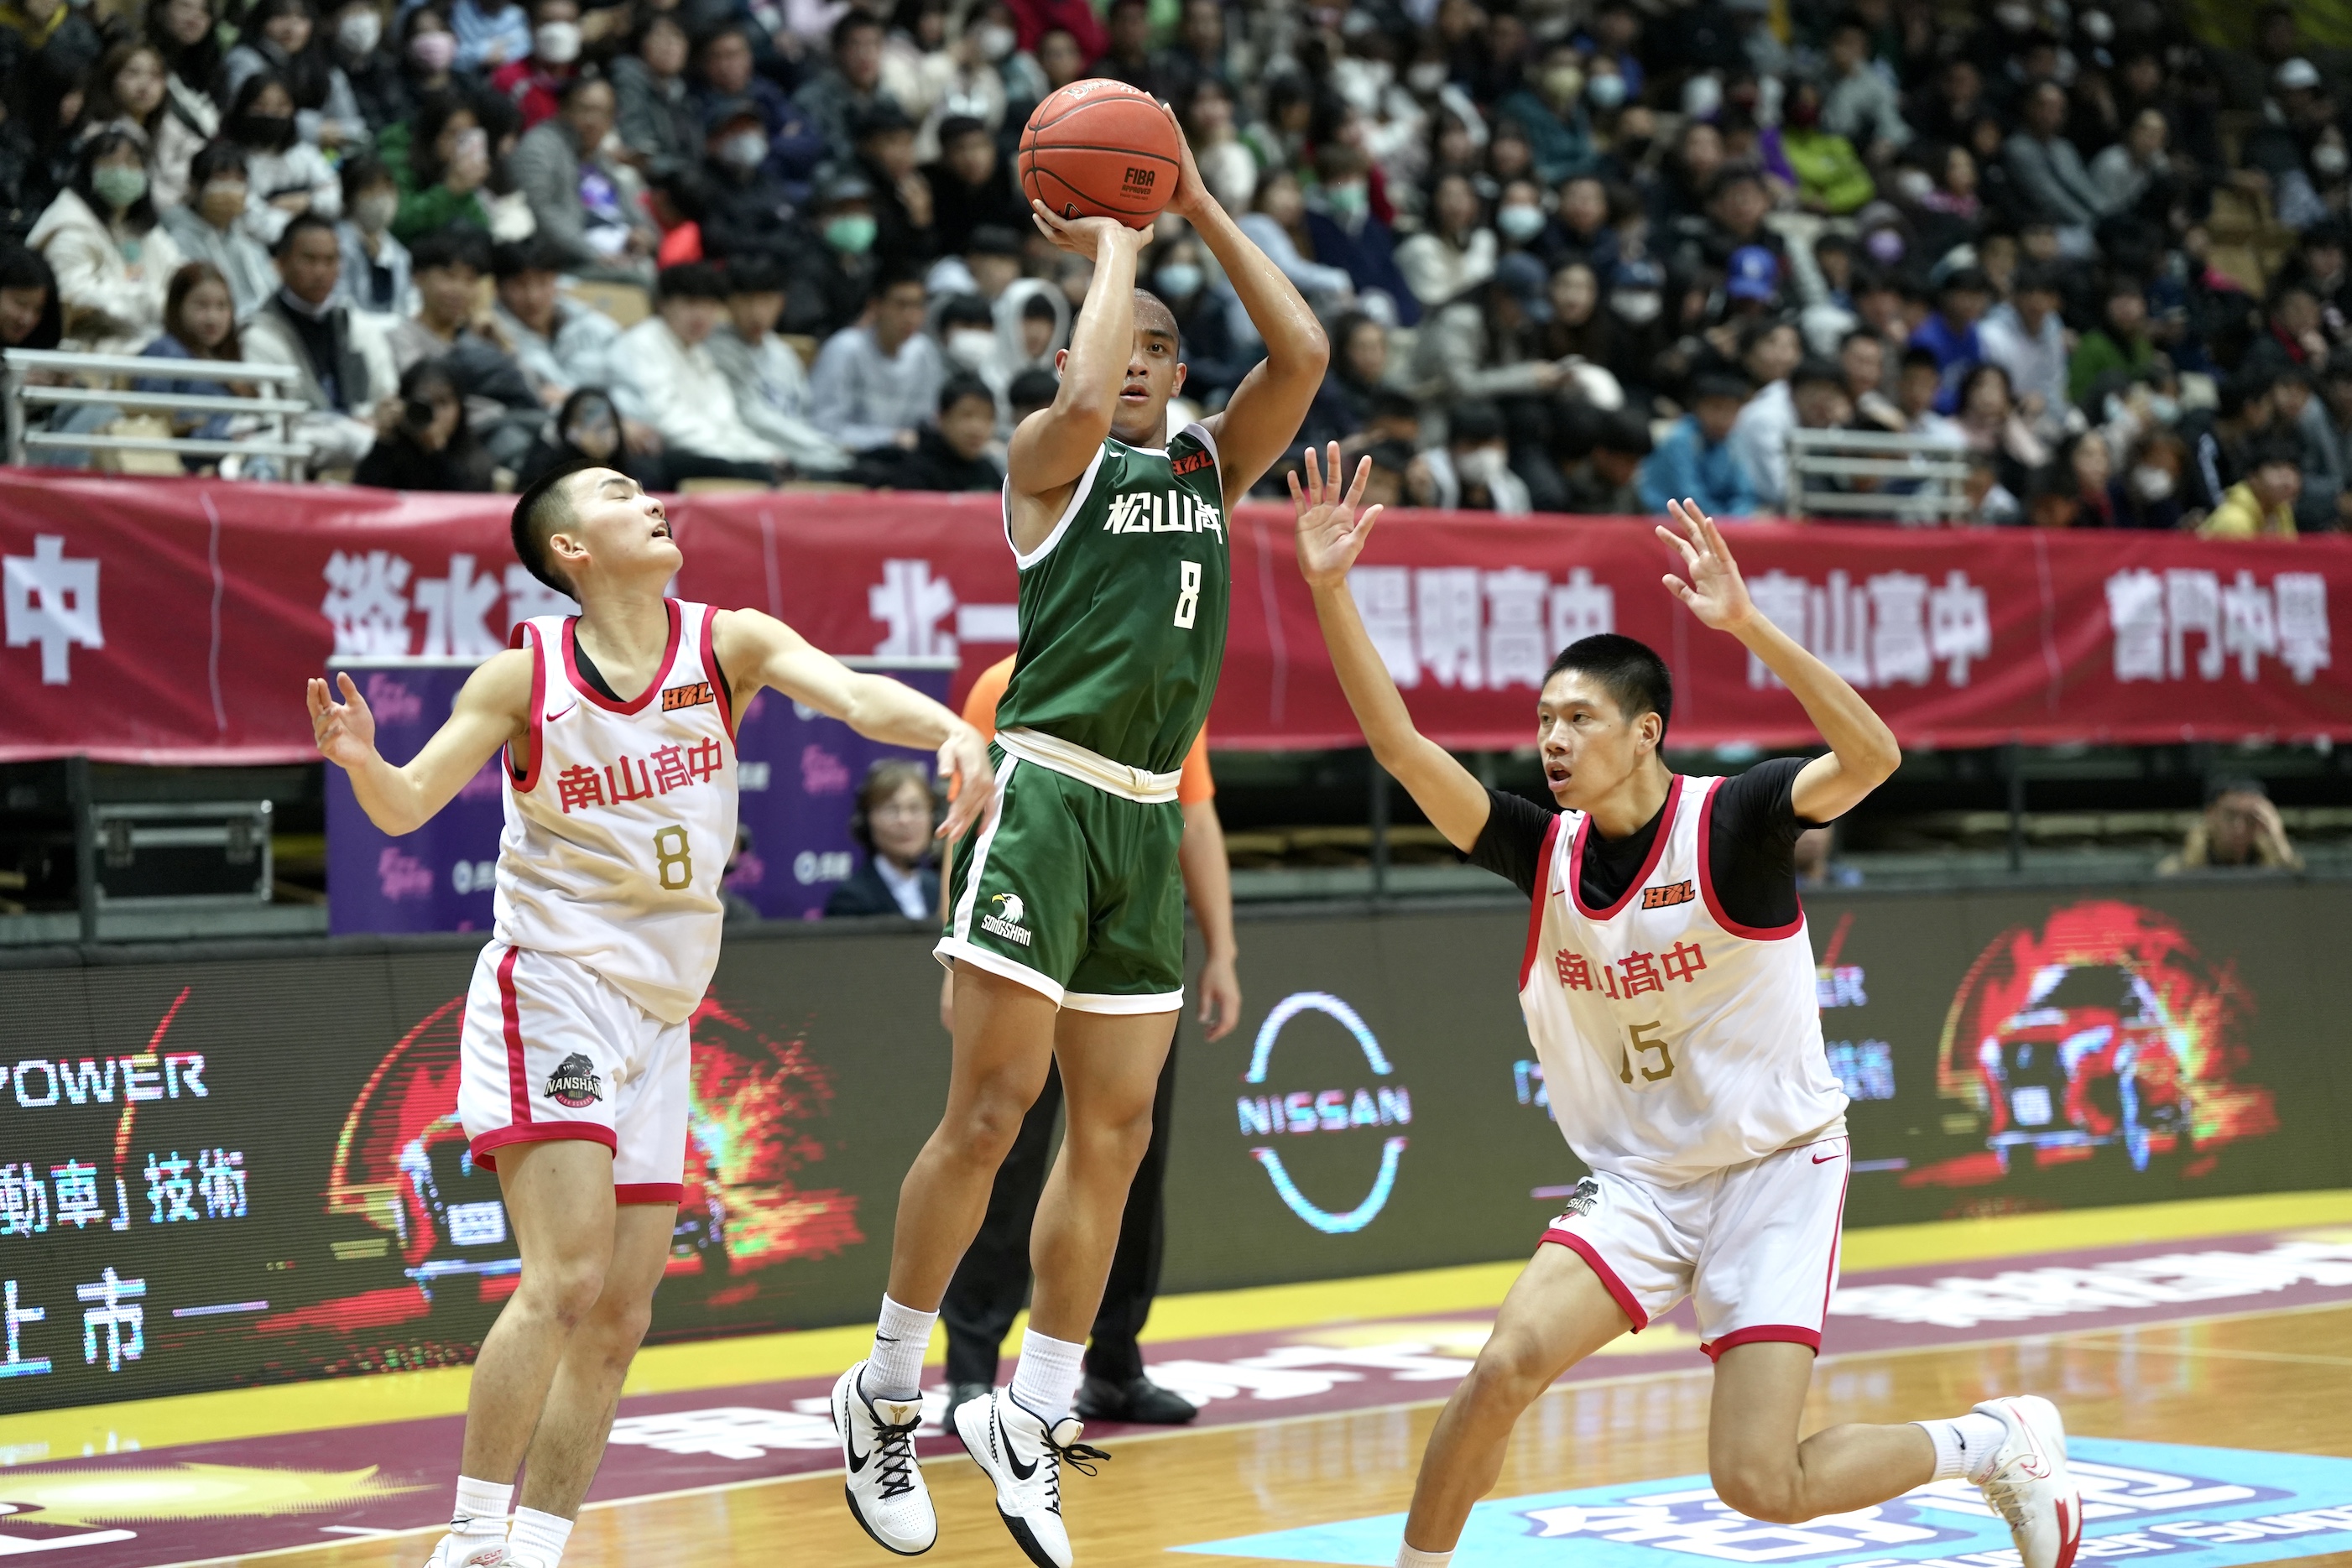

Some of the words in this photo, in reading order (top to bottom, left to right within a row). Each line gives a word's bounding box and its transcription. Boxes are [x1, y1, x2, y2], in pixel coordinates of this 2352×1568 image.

[1121, 185, 1151, 195] APPROVED
[1124, 167, 1155, 187] FIBA
[2, 533, 105, 686] 中
[1173, 560, 1202, 629] 8
[662, 682, 713, 711] HBL
[556, 736, 723, 814] 南山高中
[653, 824, 694, 890] 8
[1641, 880, 1696, 909] HBL
[981, 914, 1032, 947] SONGSHAN
[1555, 940, 1708, 1000] 南山高中
[1619, 1019, 1676, 1084] 15
[544, 1076, 602, 1100] NANSHAN
[1236, 1086, 1412, 1136] NISSAN
[1566, 1198, 1592, 1216] SHAN
[0, 1266, 147, 1378] 上市
[484, 1549, 503, 1560] CUT
